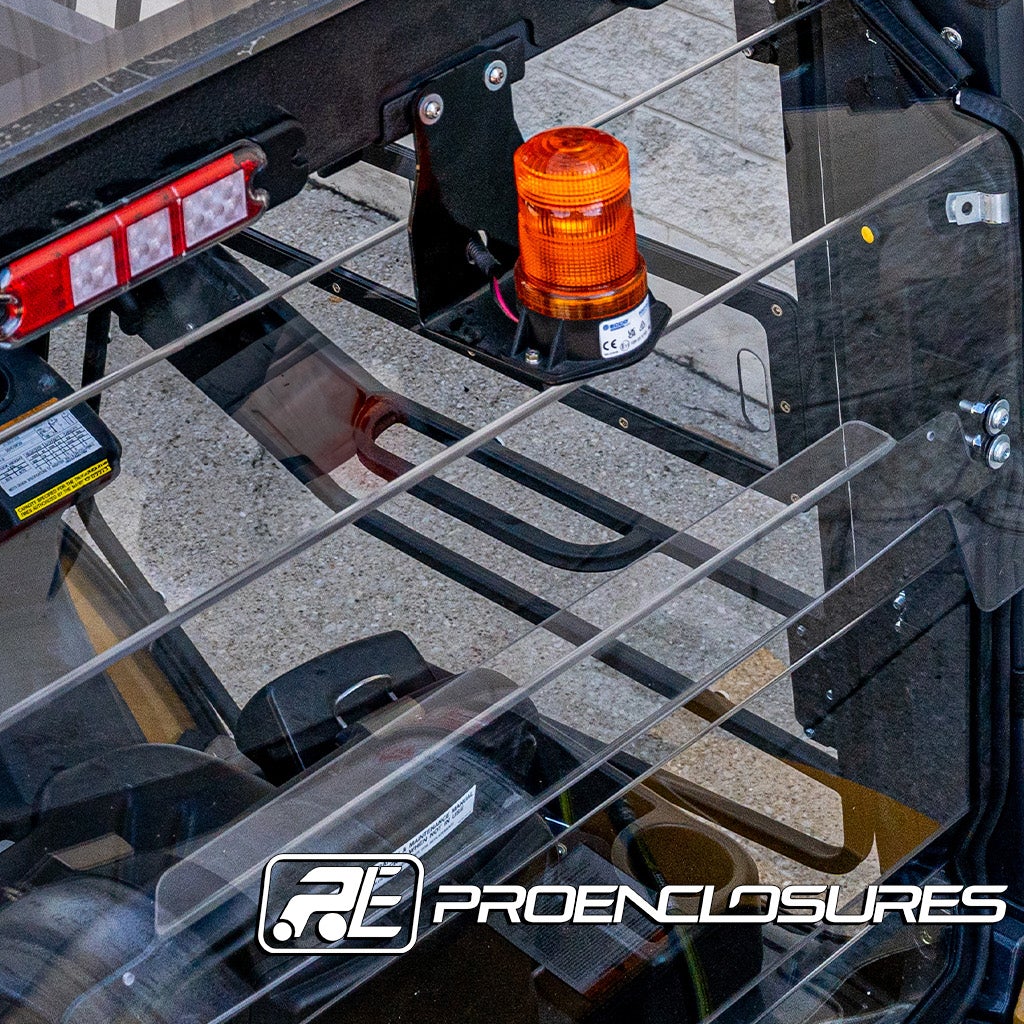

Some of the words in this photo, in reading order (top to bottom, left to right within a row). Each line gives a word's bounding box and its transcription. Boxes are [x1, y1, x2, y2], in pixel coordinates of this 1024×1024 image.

[409, 813, 450, 848] MAINTENANCE
[451, 792, 473, 812] MANUAL
[409, 837, 428, 853] WHEN
[430, 826, 441, 837] NOT
